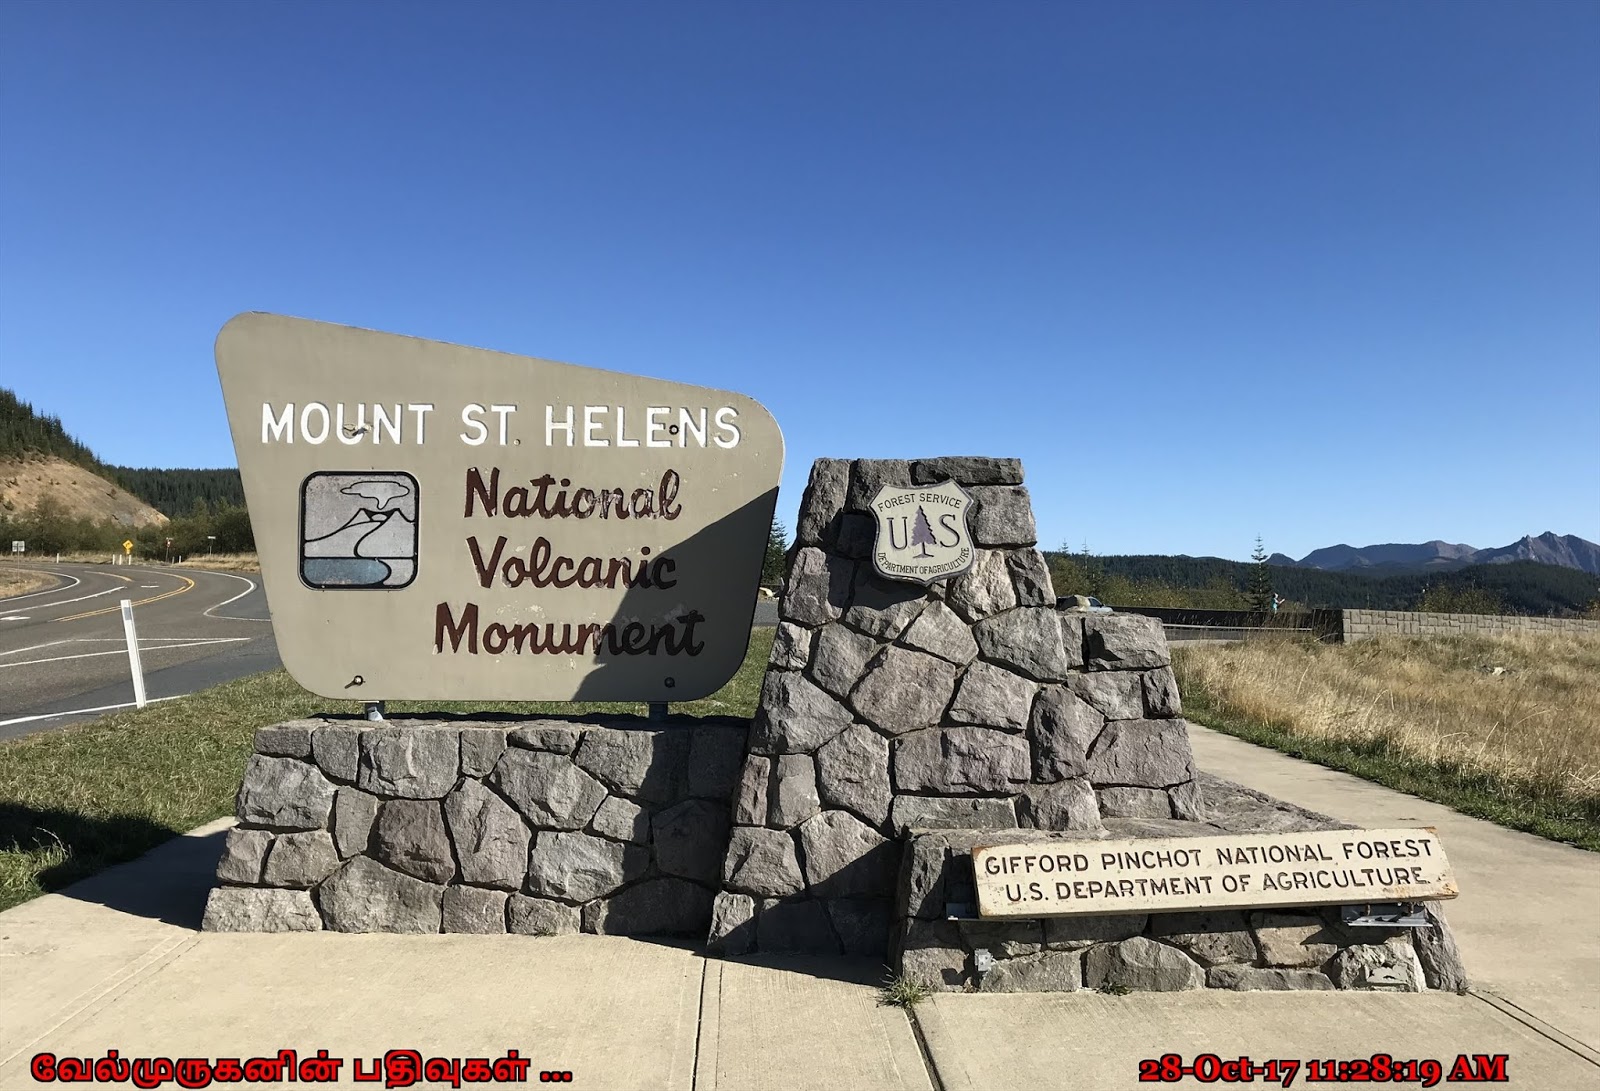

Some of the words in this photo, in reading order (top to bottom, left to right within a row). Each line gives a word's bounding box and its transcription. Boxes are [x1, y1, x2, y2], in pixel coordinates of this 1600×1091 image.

[261, 402, 434, 445] MOUNT
[545, 405, 742, 448] HELENS
[464, 467, 682, 519] National
[878, 493, 916, 512] FOREST
[919, 493, 962, 509] SERVICE
[466, 536, 677, 588] Volcanic
[878, 552, 918, 574] DEPARTMENT
[919, 565, 929, 575] OF
[928, 547, 969, 573] AGRICULTURE
[433, 602, 706, 655] Monument
[985, 853, 1090, 876] GIFFORD
[1102, 849, 1203, 871] PINCHOT
[1217, 844, 1334, 866] NATIONAL
[1343, 839, 1433, 860] FOREST
[1005, 882, 1050, 901] U.S.
[1056, 875, 1214, 900] DEPARTMENT
[1222, 874, 1251, 893] OF
